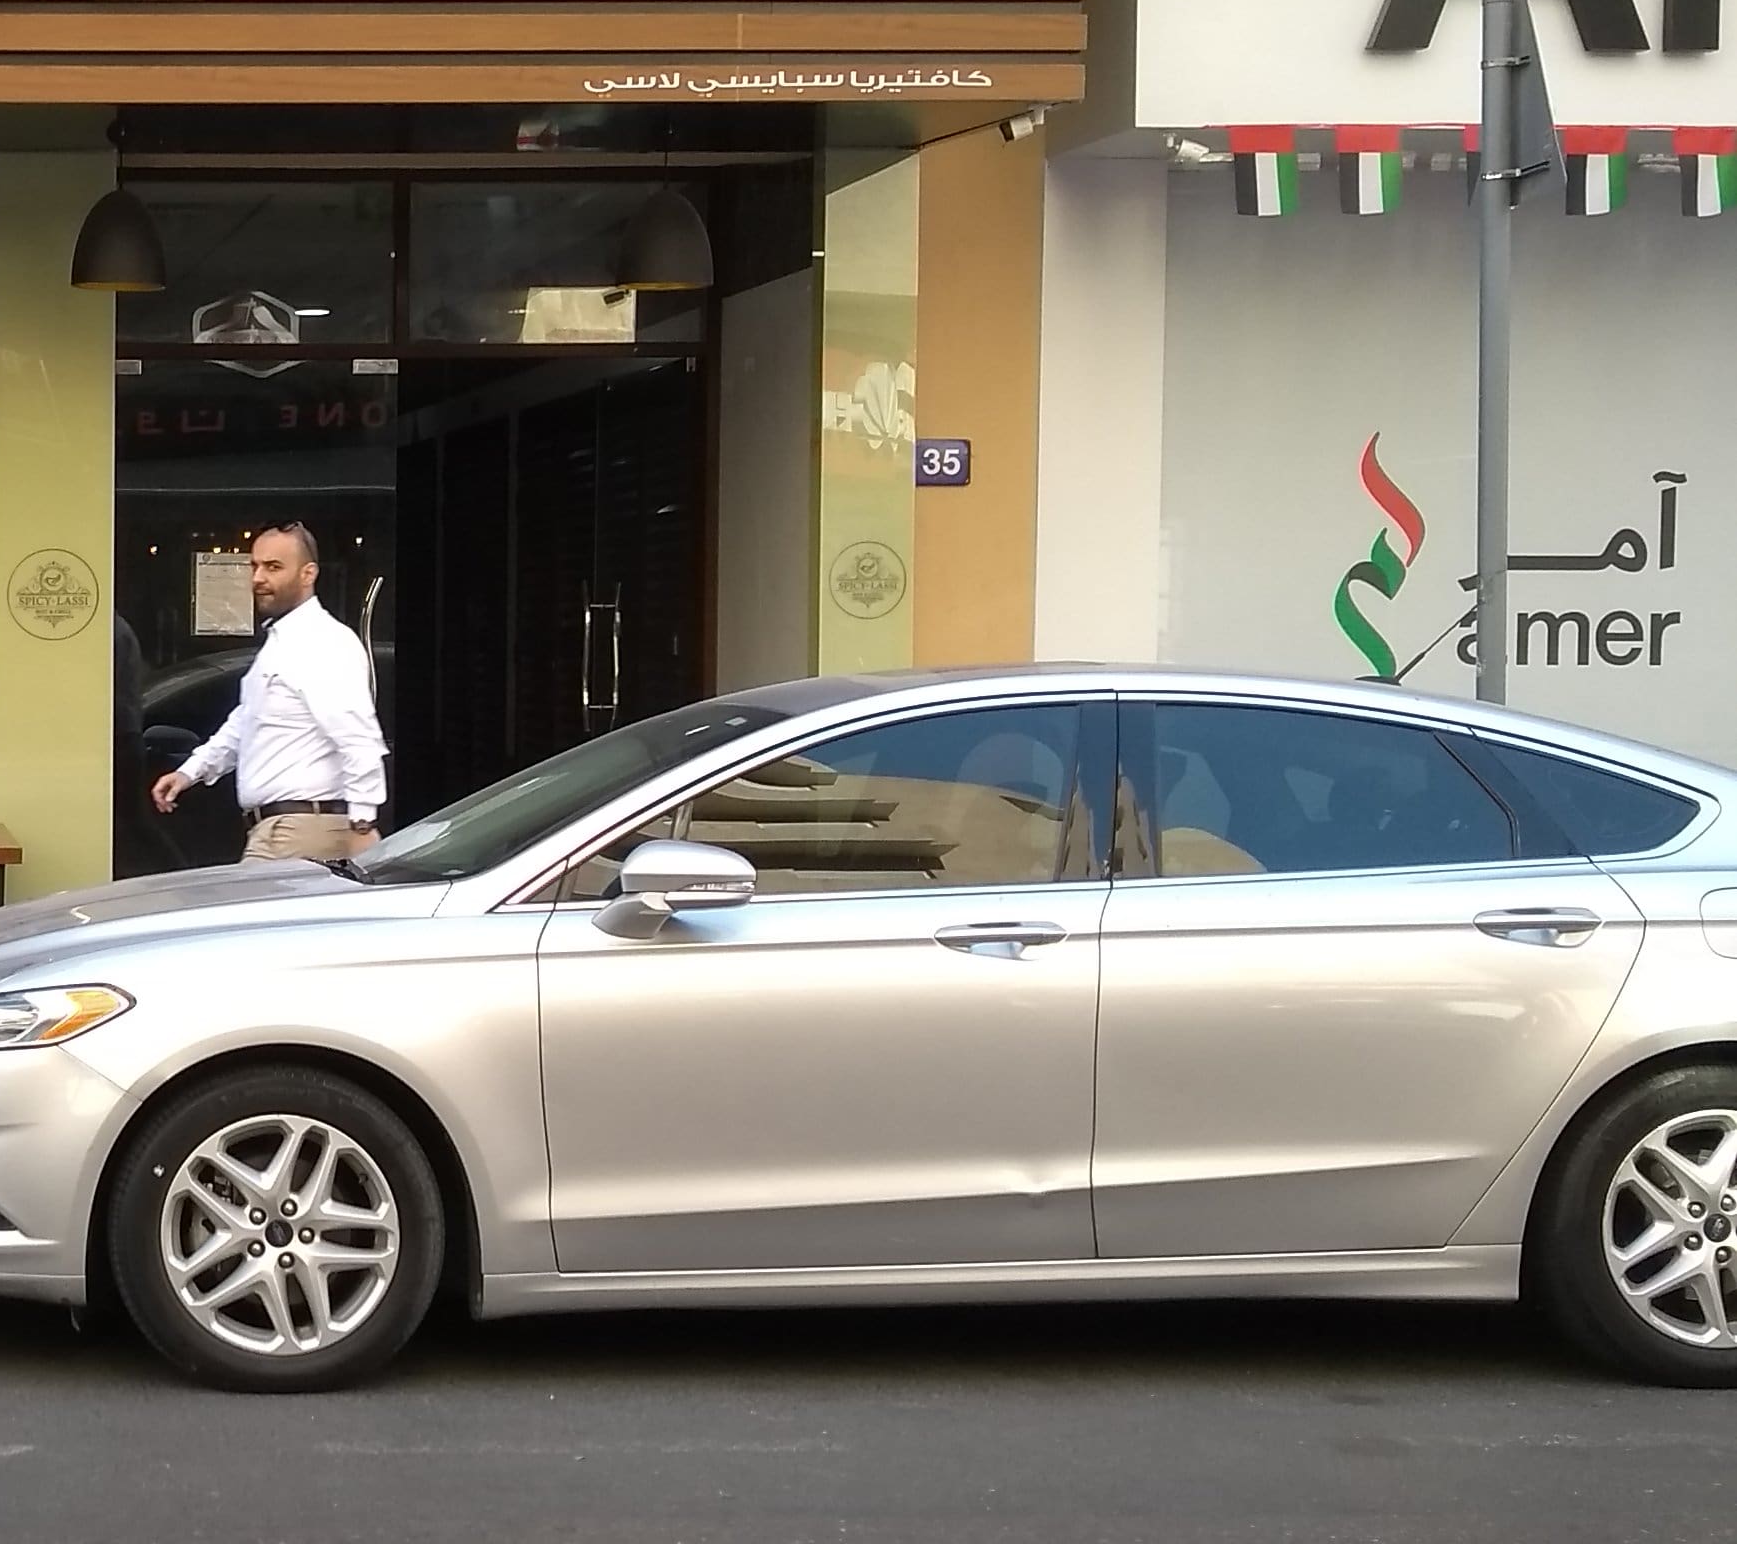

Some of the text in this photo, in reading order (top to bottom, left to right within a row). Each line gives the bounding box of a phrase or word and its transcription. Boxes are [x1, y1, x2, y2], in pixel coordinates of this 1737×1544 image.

[582, 68, 993, 98] كافتيريا سبايسي لاسي
[922, 447, 962, 476] 35
[18, 596, 89, 606] SPICY LASSI
